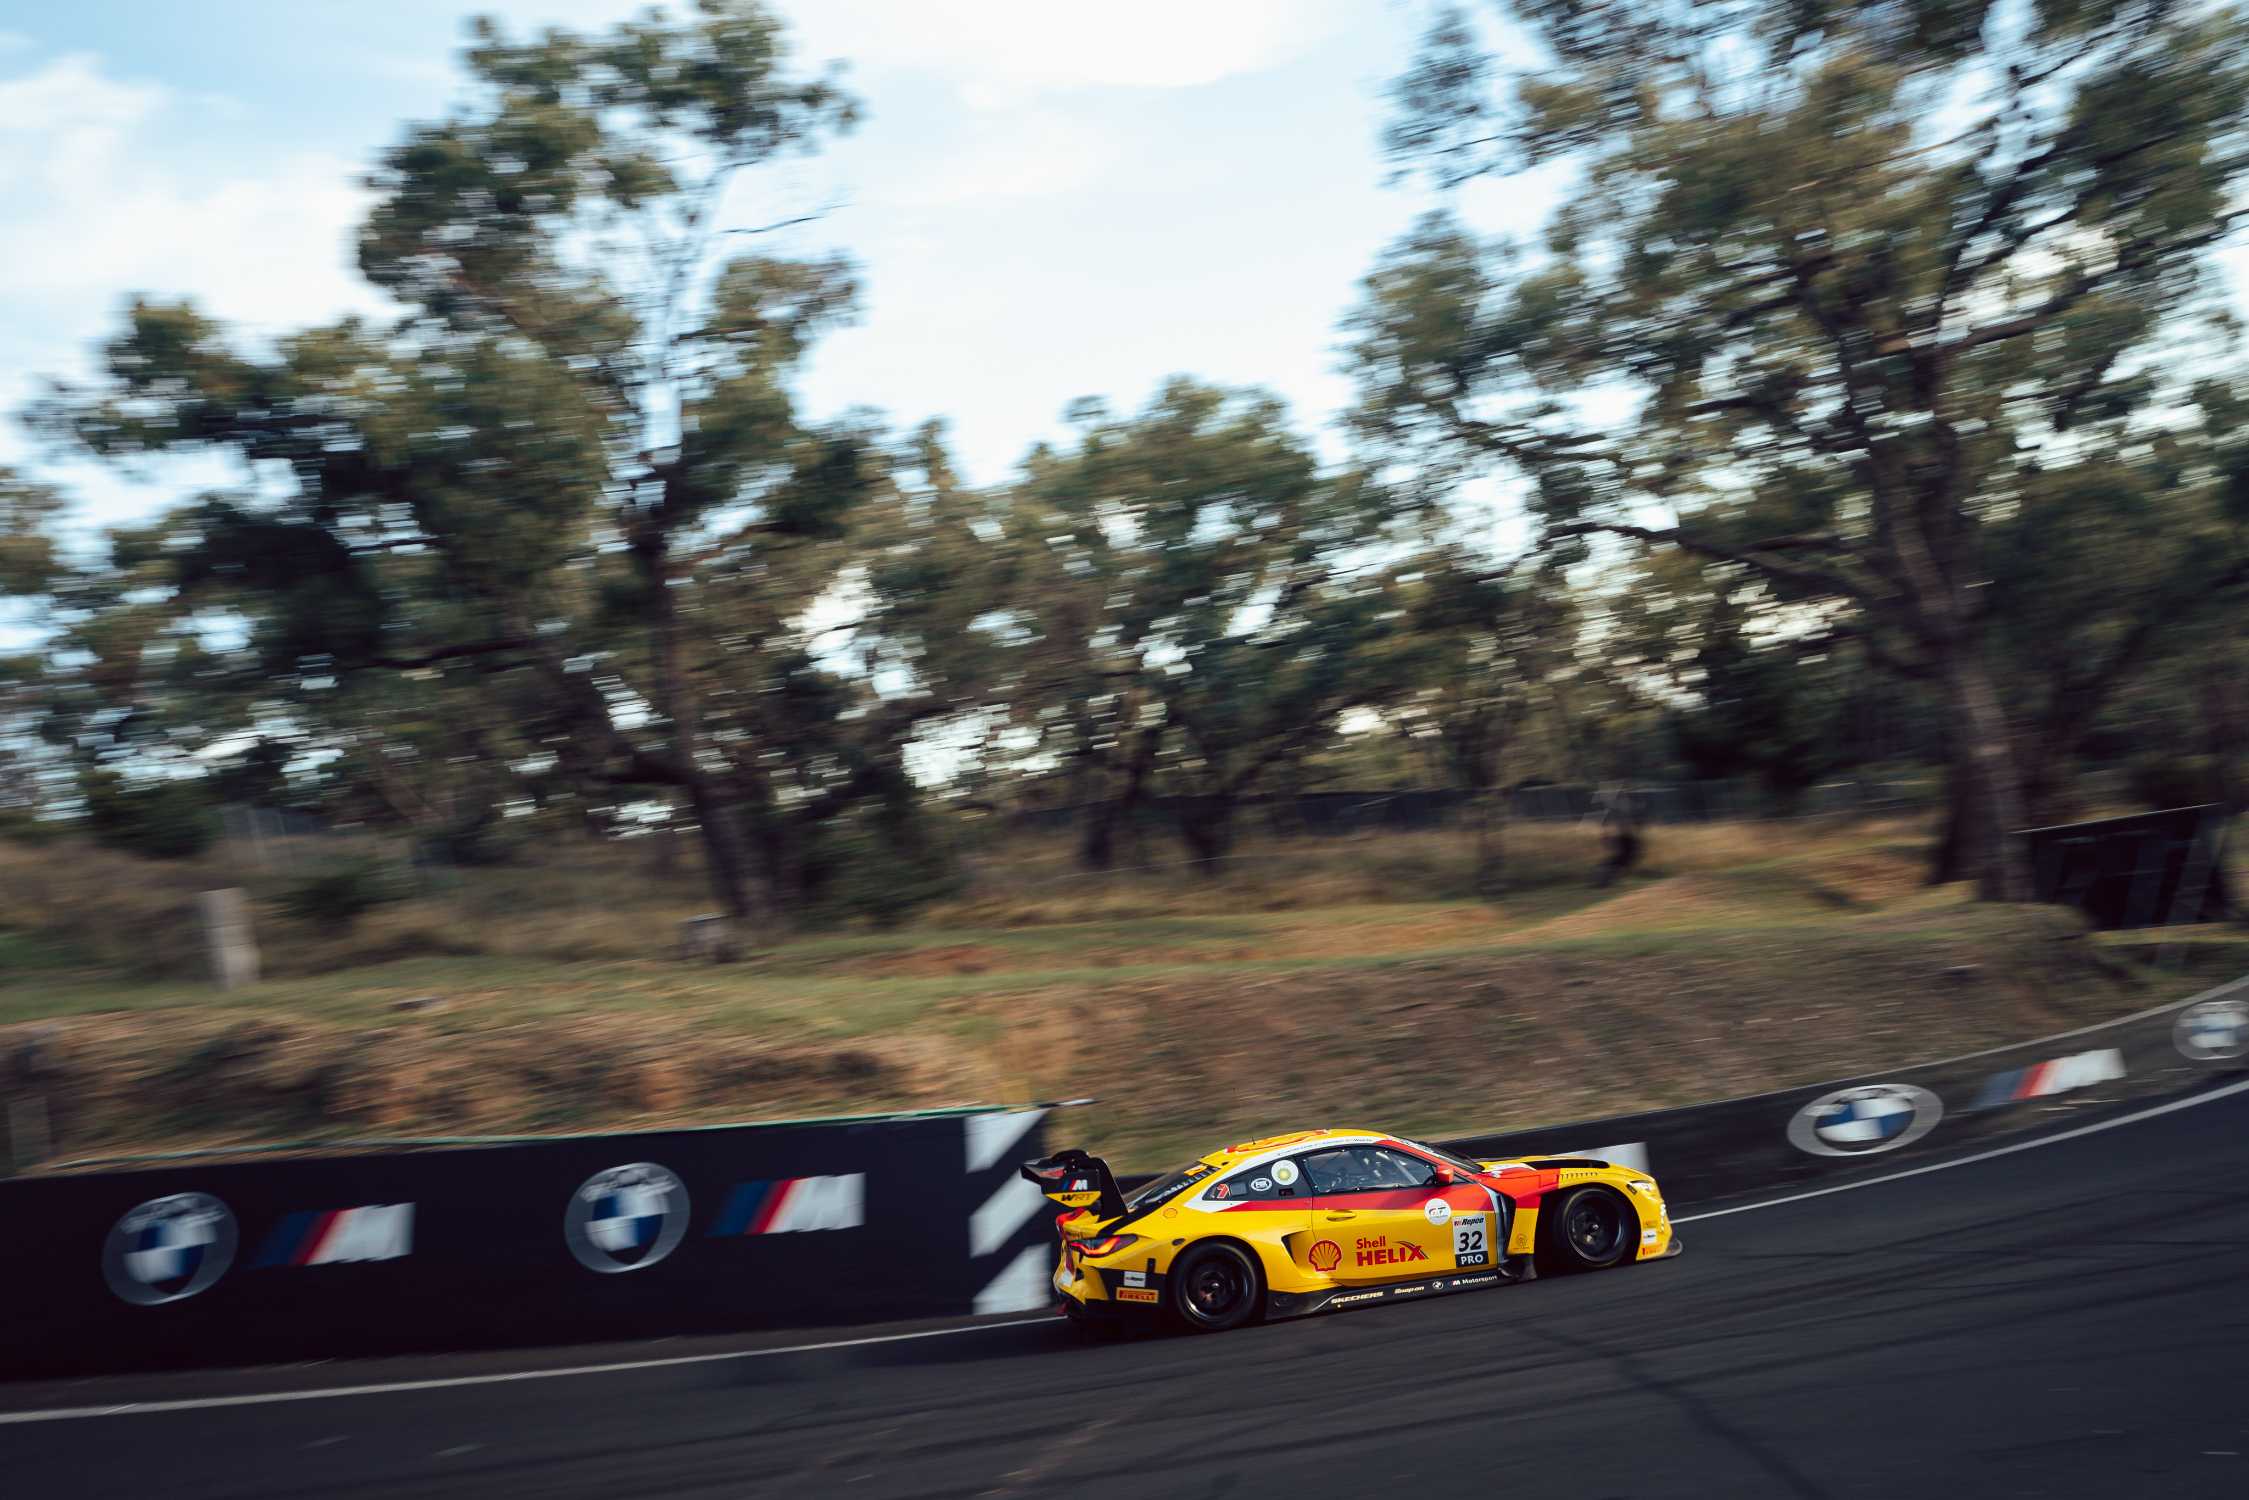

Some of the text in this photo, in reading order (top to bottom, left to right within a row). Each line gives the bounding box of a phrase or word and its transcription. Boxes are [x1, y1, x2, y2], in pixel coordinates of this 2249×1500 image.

[1072, 1180, 1088, 1191] M
[1061, 1192, 1094, 1202] WRT
[1356, 1235, 1386, 1249] Shell
[1458, 1231, 1483, 1252] 32
[1356, 1245, 1426, 1266] HELIX
[1460, 1254, 1484, 1265] PRO
[1462, 1275, 1498, 1285] Motorsport
[1331, 1291, 1384, 1304] SKECHERS
